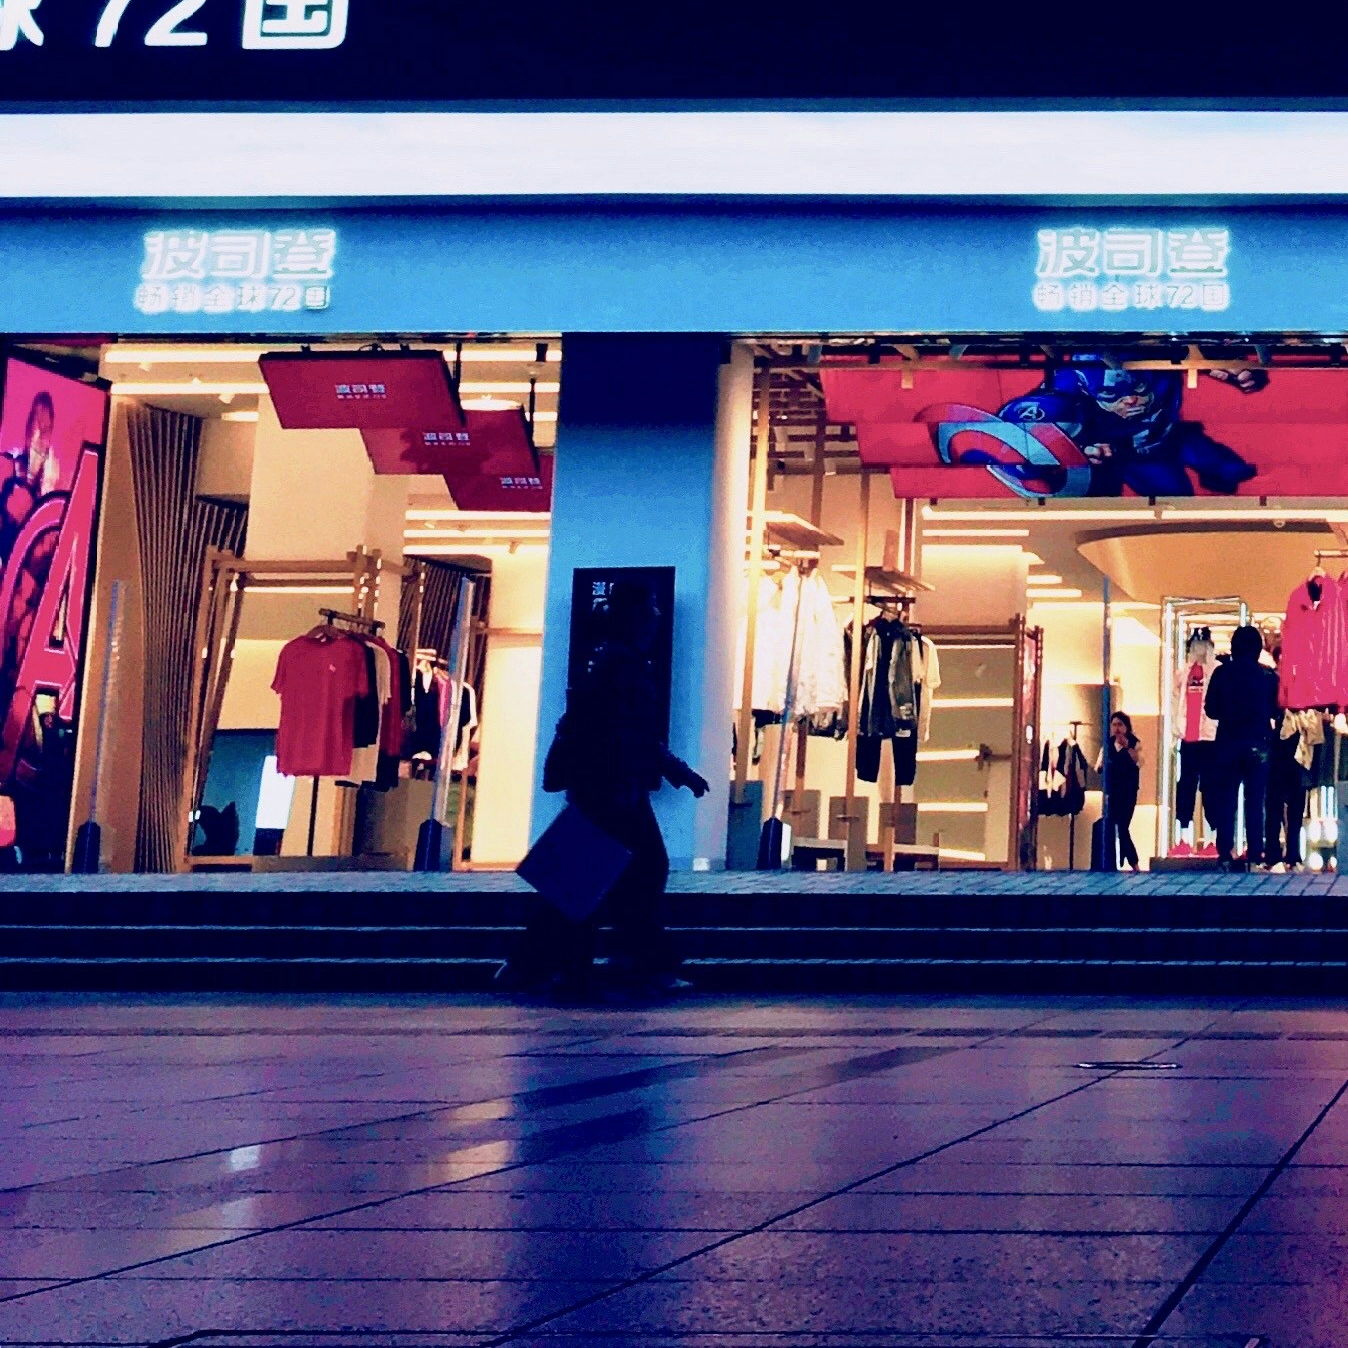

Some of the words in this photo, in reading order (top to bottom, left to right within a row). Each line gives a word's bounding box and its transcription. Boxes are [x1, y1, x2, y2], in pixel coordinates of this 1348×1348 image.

[142, 230, 335, 280] 波司登
[1038, 229, 1228, 278] 波司登
